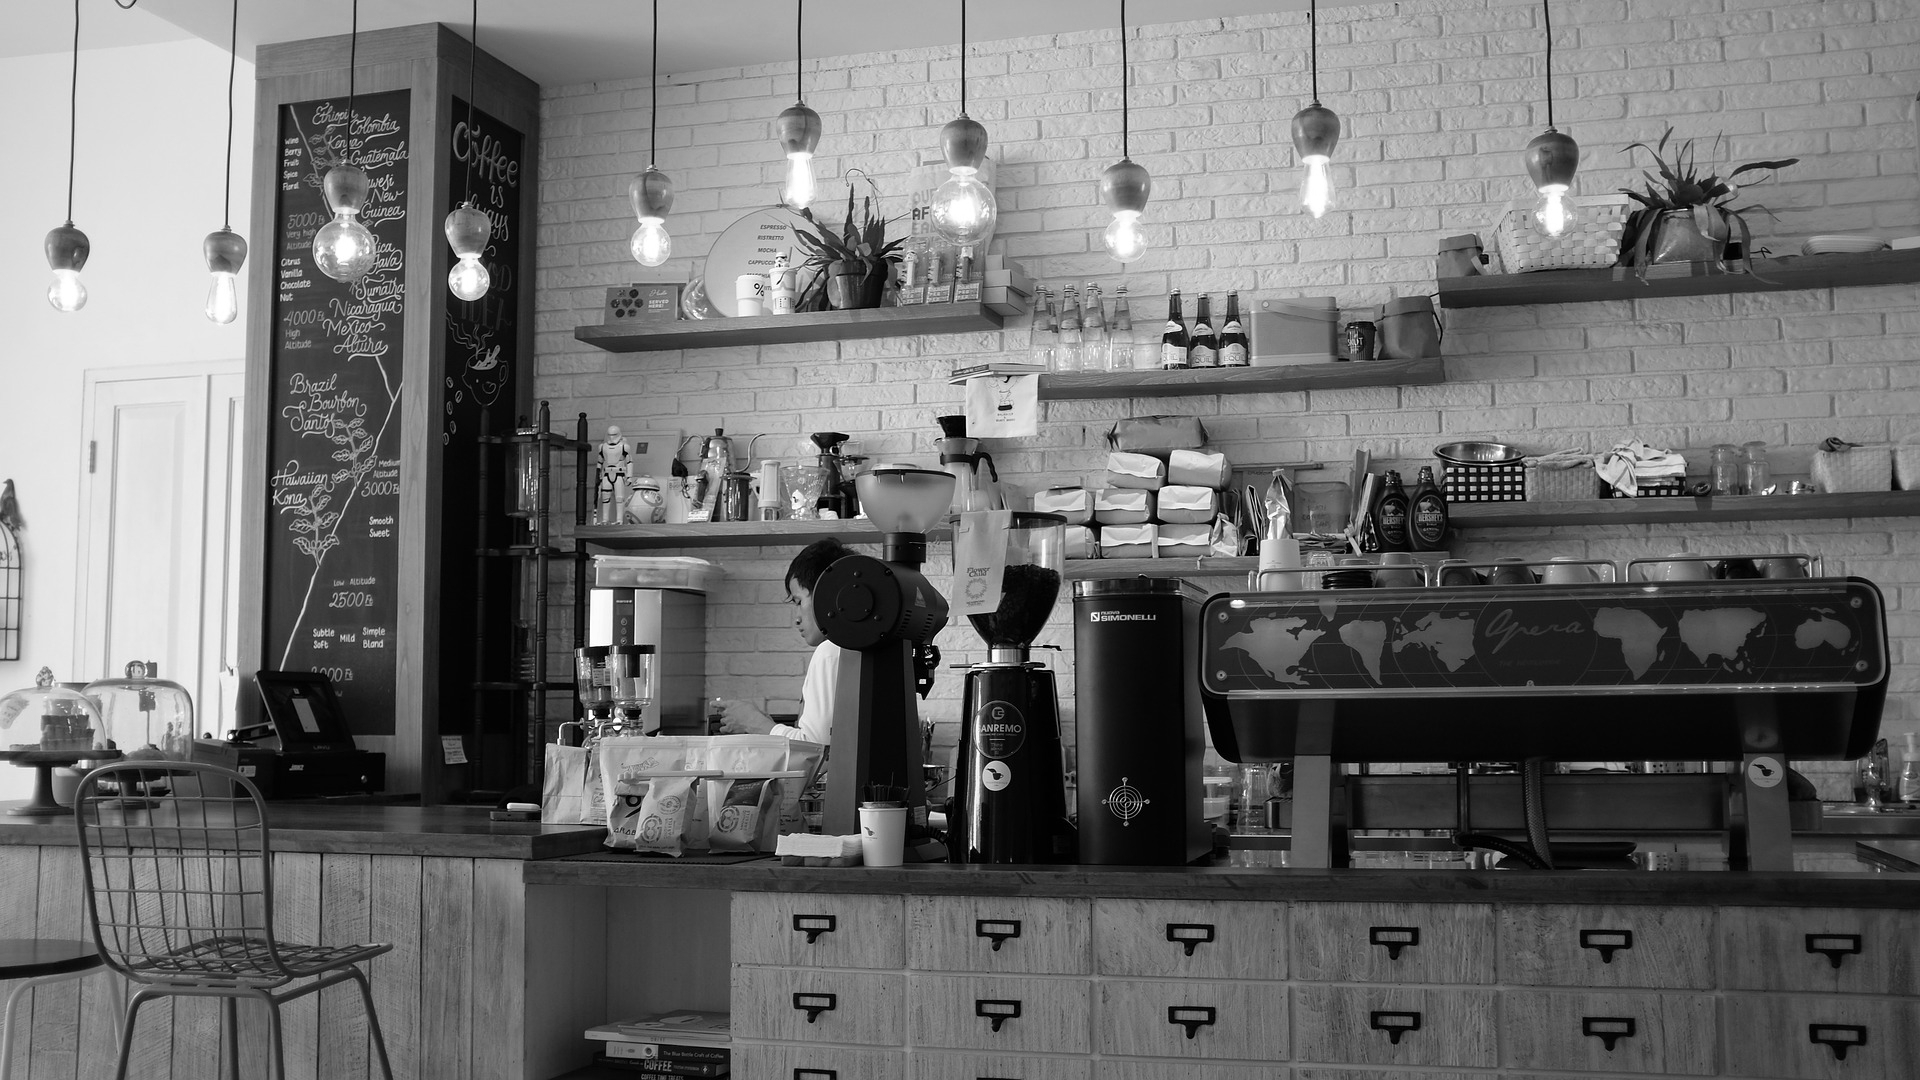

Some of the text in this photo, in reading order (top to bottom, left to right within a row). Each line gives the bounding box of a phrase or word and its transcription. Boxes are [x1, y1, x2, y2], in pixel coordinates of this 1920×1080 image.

[349, 113, 400, 138] Colombia
[284, 148, 302, 157] Berry
[350, 141, 409, 167] Guatemala
[453, 121, 518, 187] Coffee
[283, 159, 299, 167] Fruit
[283, 171, 298, 180] Spice
[282, 182, 299, 191] Floral
[370, 188, 404, 203] New
[490, 182, 504, 208] is
[361, 202, 406, 223] Guinea
[287, 212, 317, 229] 5000
[286, 240, 312, 250] Altitude
[280, 258, 301, 267] Citrus
[367, 250, 403, 275] Java
[280, 268, 303, 279] Vanilla
[280, 279, 311, 290] Chocolate
[356, 274, 406, 301] Sumatra
[279, 293, 294, 302] Nut
[329, 298, 403, 321] Nicaragua
[283, 309, 317, 326] 4000
[322, 318, 386, 337] Mexico
[285, 329, 301, 340] High
[284, 339, 312, 350] Altitude
[333, 335, 389, 358] Altura
[289, 372, 338, 394] Brazil
[307, 390, 368, 417] Bourbon
[282, 400, 336, 438] Santos
[270, 460, 335, 492] Hawaiian
[372, 469, 398, 479] Altitude
[361, 481, 392, 497] 3000
[272, 487, 308, 511] Kona
[369, 516, 394, 526] Smooth
[369, 528, 391, 538] Sweet
[350, 576, 376, 586] Altitude
[329, 591, 364, 608] 2500
[1101, 614, 1156, 622] SIMONELLI
[313, 628, 335, 638] Subtle
[362, 626, 386, 638] Simple
[1485, 608, 1585, 655] Opera
[339, 633, 356, 643] Mild
[362, 639, 384, 649] Bland
[313, 640, 329, 649] Soft
[979, 723, 1022, 733] ANREMO
[613, 827, 636, 836] ARAB
[643, 1059, 672, 1072] COFFEE
